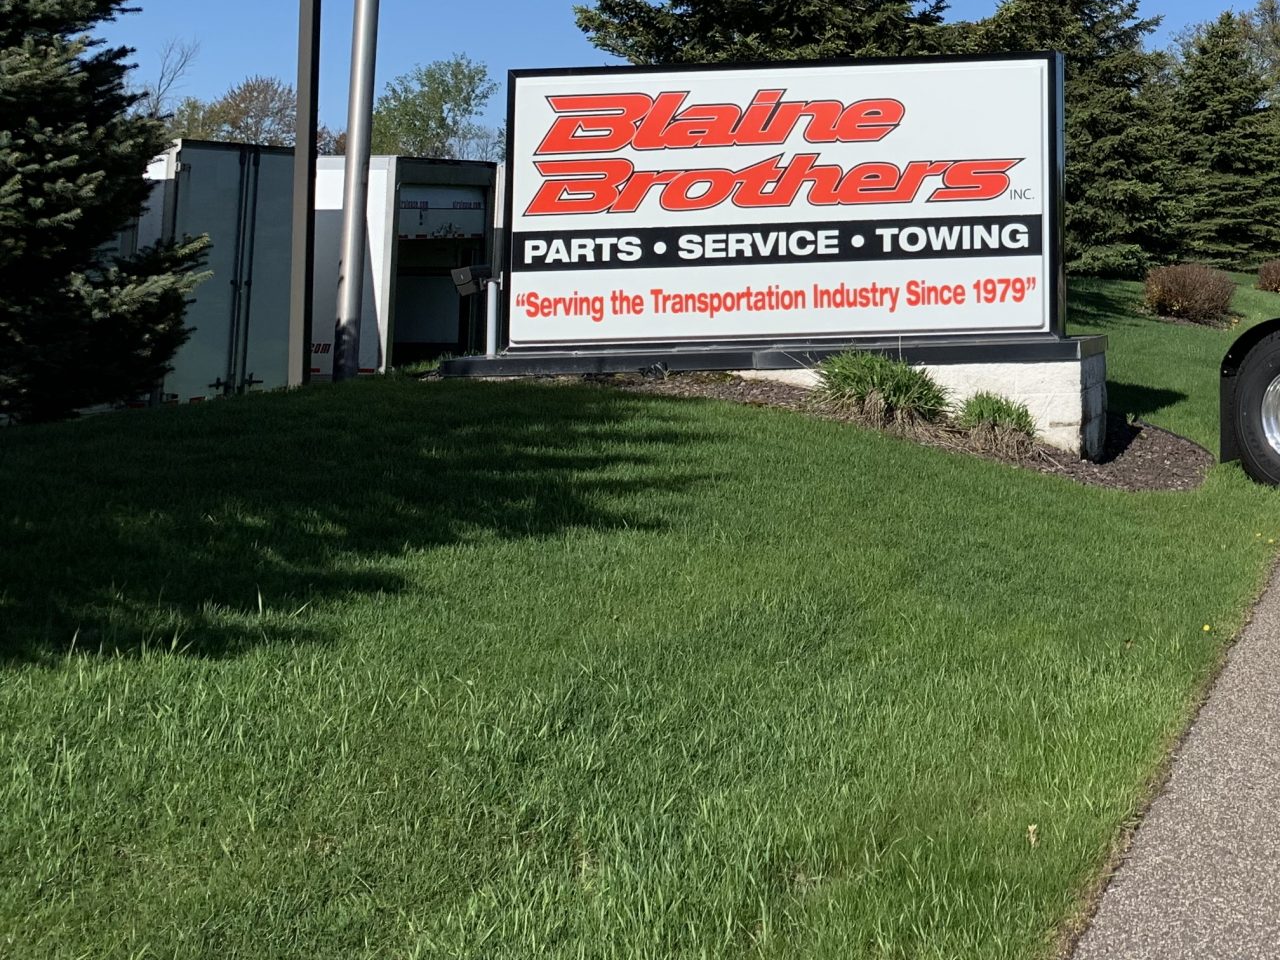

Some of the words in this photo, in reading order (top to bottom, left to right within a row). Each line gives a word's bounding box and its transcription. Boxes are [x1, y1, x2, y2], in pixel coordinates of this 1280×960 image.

[533, 88, 905, 156] Blaine
[522, 152, 1025, 217] Brothers
[1009, 188, 1035, 200] INC.
[524, 236, 643, 265] PARTS
[677, 229, 840, 260] SERVICE
[875, 223, 1030, 253] TOWING
[610, 290, 645, 316] the
[650, 284, 806, 319] Transportation
[813, 281, 900, 313] Industry
[905, 279, 967, 307] Since
